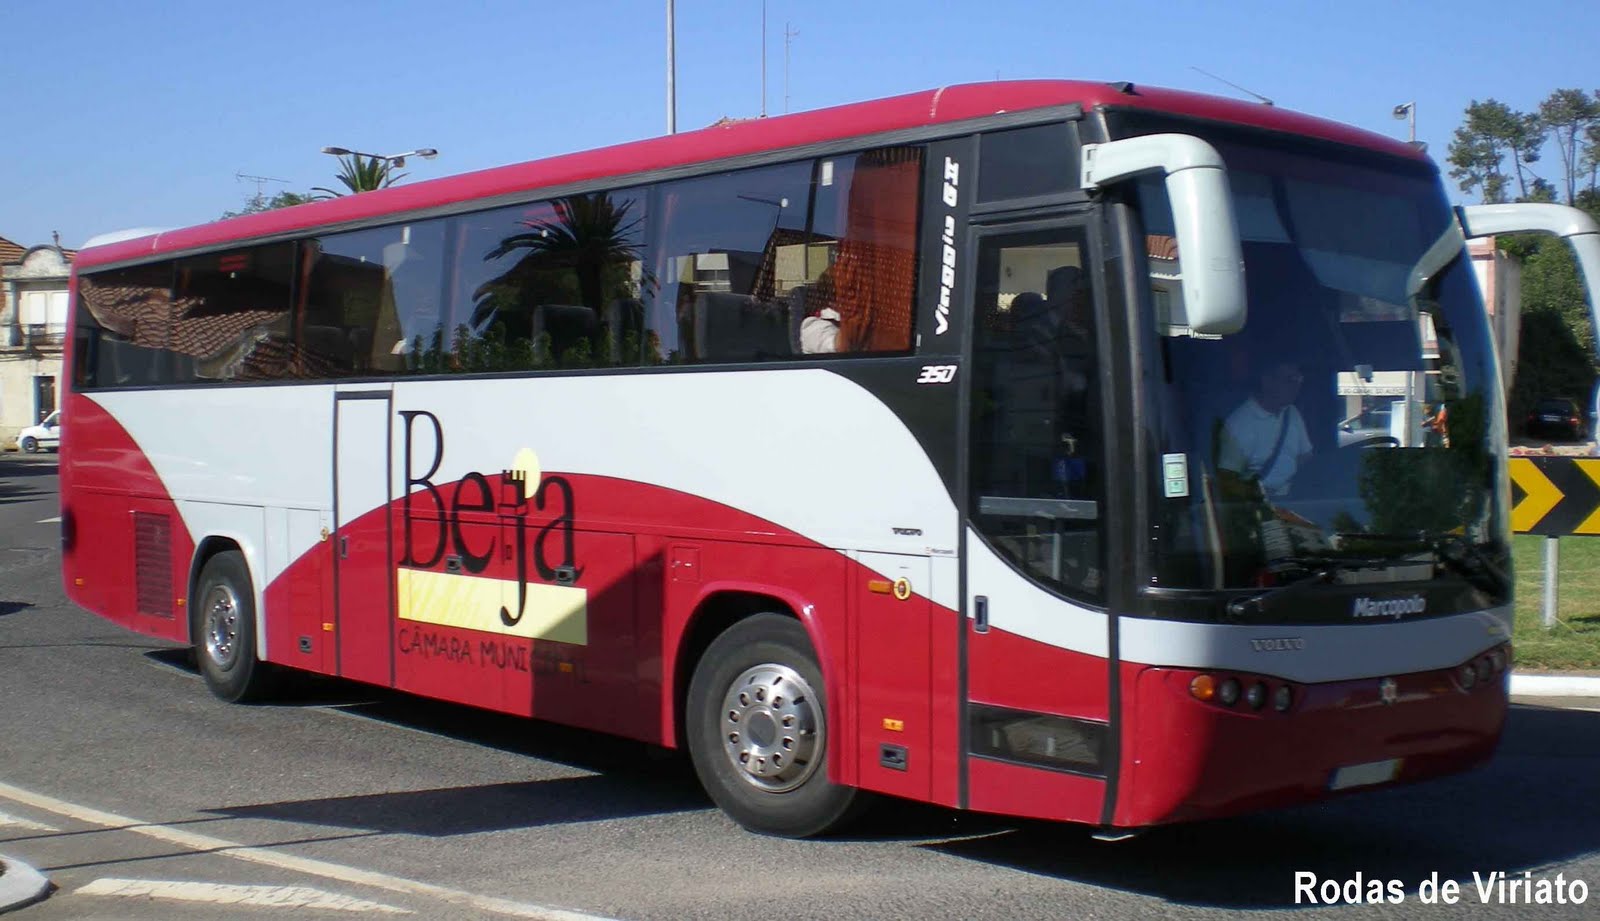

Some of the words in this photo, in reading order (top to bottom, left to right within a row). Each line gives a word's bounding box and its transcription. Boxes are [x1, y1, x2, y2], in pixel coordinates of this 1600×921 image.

[935, 215, 957, 335] Viaggio
[917, 365, 957, 383] 350
[397, 410, 585, 627] Beja
[1353, 594, 1426, 619] Marcopolo
[399, 627, 474, 664] CÂMARA
[1251, 638, 1305, 651] VOLVO
